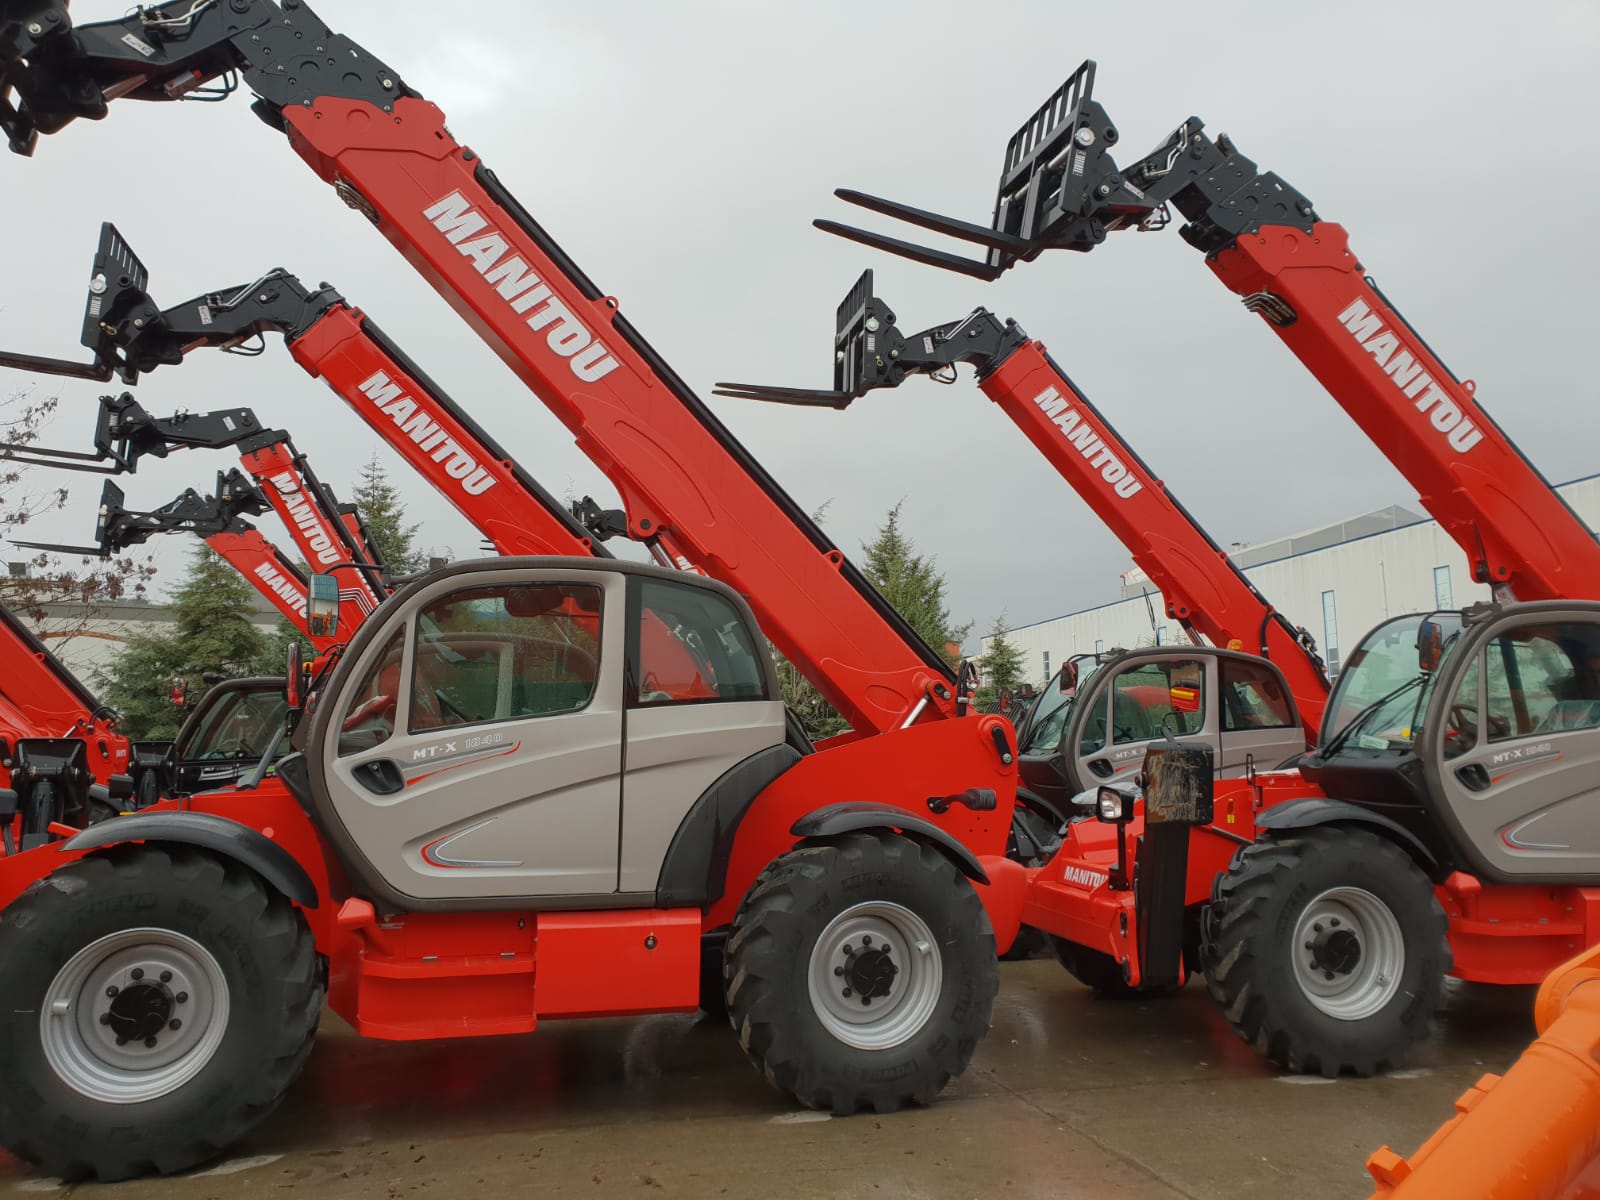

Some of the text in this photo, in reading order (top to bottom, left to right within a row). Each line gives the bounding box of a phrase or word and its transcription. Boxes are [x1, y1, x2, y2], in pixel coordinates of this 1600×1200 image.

[422, 190, 620, 383] MANITOU
[358, 370, 497, 496] MANITOU
[1337, 298, 1483, 454] MANITOU
[1033, 385, 1143, 499] MANITOU
[270, 471, 341, 565] MANITOU
[412, 733, 503, 760] MT-X 1840
[1493, 748, 1522, 764] MT-X
